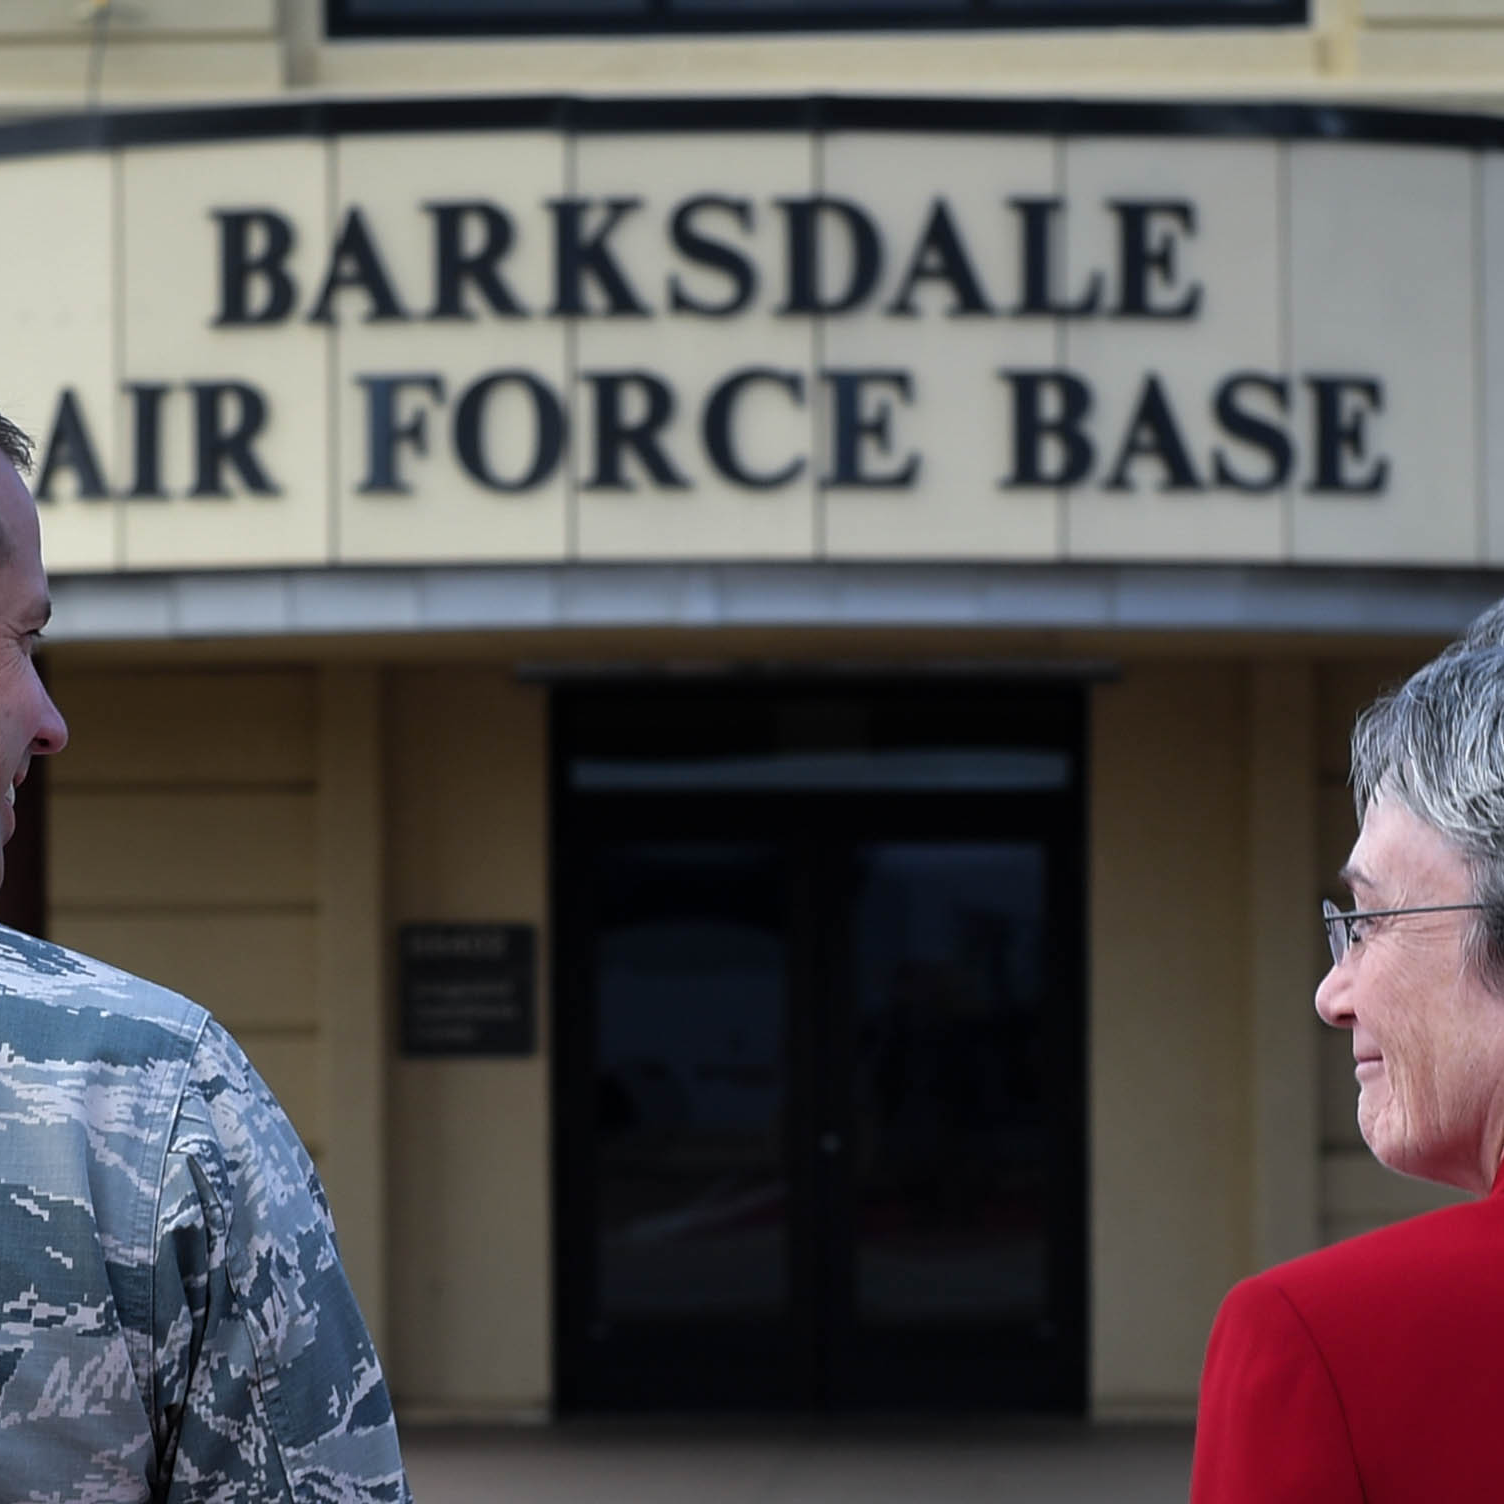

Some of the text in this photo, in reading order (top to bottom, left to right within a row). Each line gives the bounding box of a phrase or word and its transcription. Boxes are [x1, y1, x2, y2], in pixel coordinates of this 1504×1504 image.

[209, 195, 1203, 328] BARKSDALE
[37, 367, 1391, 503] AIR FORCE BASE
